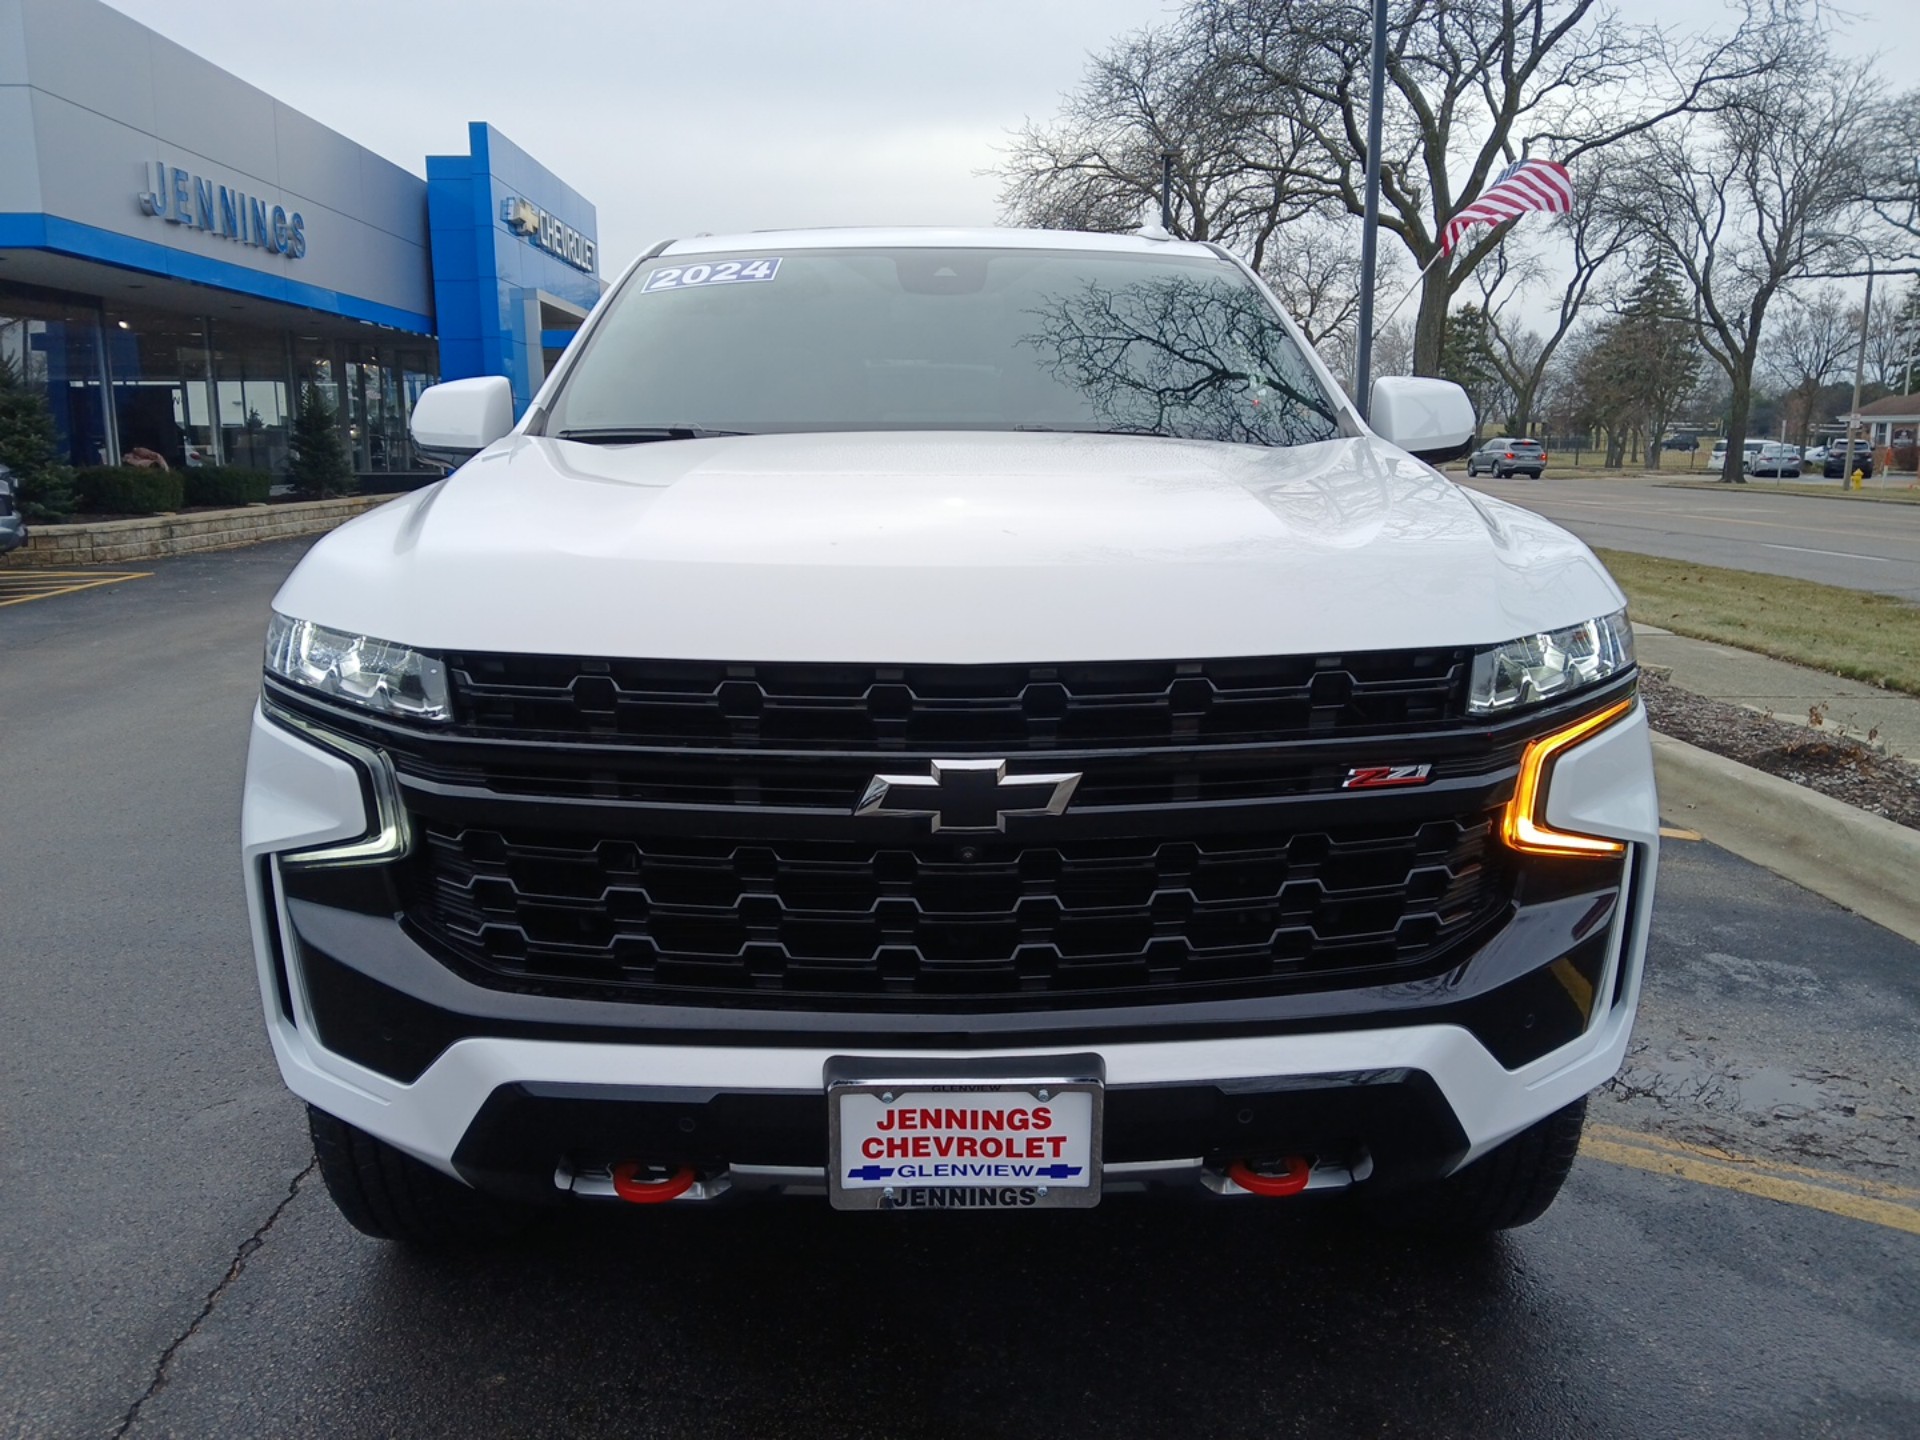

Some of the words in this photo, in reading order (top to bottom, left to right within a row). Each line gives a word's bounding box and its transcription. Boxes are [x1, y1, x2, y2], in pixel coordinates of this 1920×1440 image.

[140, 161, 306, 259] JENNINGS
[539, 210, 596, 273] CHEVROLET
[649, 260, 771, 289] 2024
[931, 1085, 1003, 1093] GLENVIEW
[877, 1107, 1052, 1130] JENNINGS
[861, 1136, 1067, 1159] CHEVROLET
[897, 1164, 1034, 1178] GLENVIEW
[895, 1188, 1037, 1207] JENNINGS
